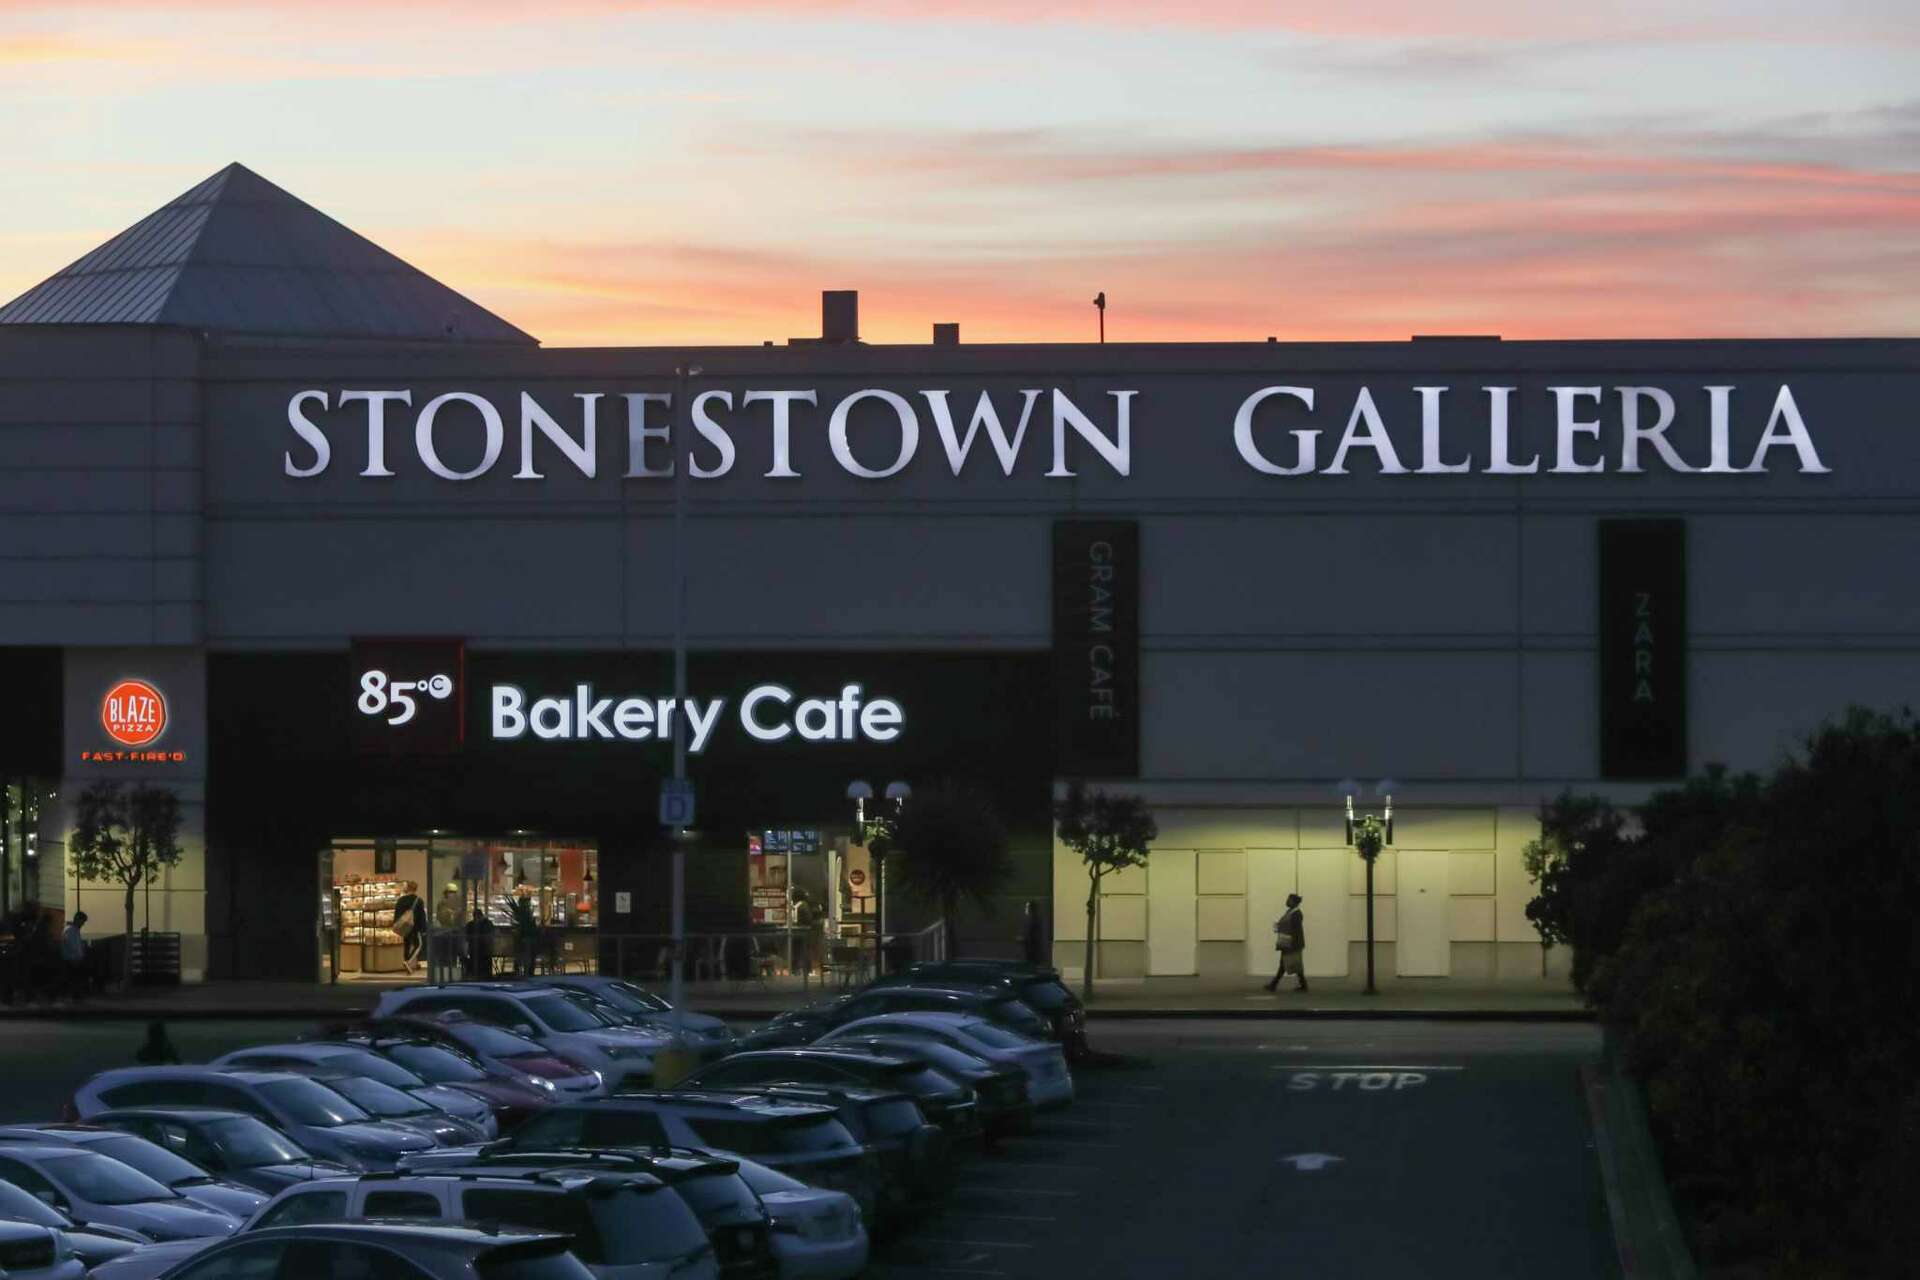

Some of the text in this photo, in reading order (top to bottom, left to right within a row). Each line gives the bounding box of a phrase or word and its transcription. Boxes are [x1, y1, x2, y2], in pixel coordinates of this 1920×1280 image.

[285, 384, 1832, 480] STONESTOWN GALLERIA
[1089, 540, 1112, 633] GRAM
[1633, 592, 1654, 703] ZARA
[110, 695, 156, 722] BLAZE
[113, 724, 154, 732] PIZZA
[491, 684, 904, 752] Bakery Cafe
[1287, 1072, 1427, 1090] STOP
